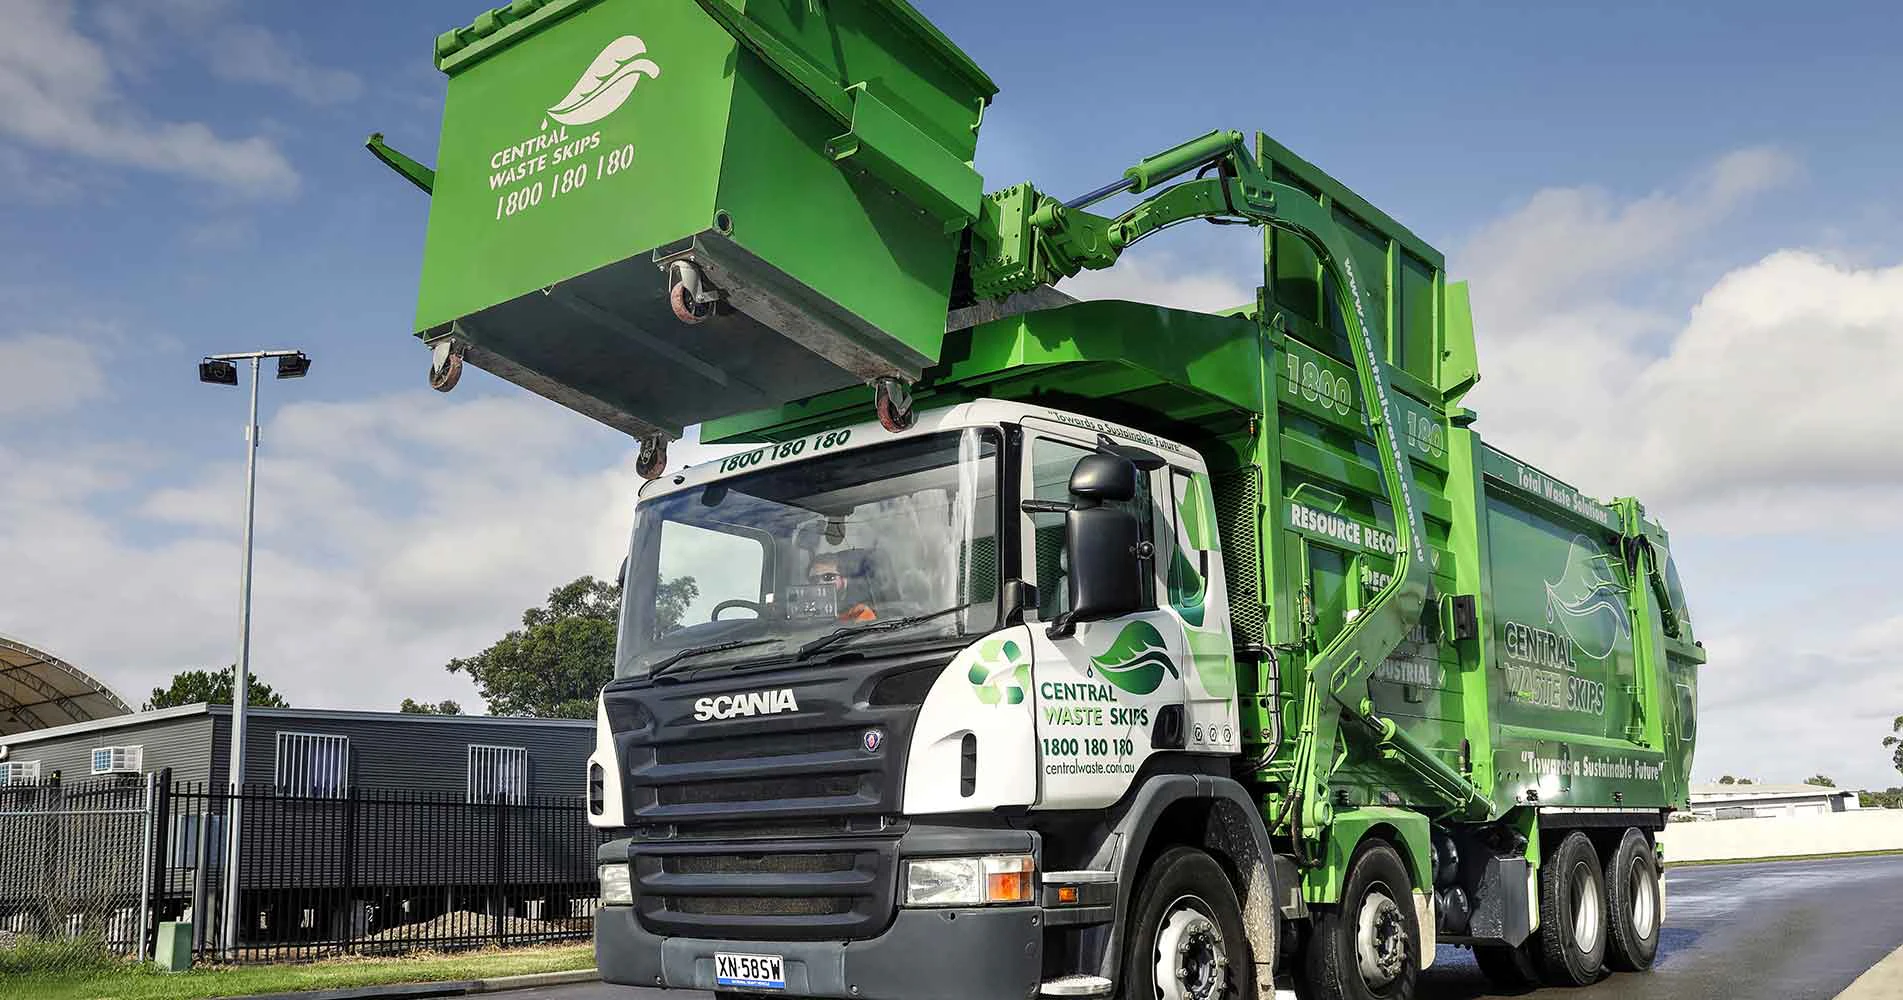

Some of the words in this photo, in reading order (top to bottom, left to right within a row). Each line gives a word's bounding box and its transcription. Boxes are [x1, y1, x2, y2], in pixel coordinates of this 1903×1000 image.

[489, 154, 548, 190] WASTE
[552, 131, 601, 165] SKIPS
[491, 125, 569, 169] CENTRAL
[496, 182, 543, 220] 1800
[551, 164, 588, 198] 180
[597, 143, 635, 180] 180
[1287, 353, 1351, 416] 1800
[1407, 410, 1444, 457] 180
[1344, 256, 1425, 562] www.centralwaste.com.au
[719, 450, 764, 473] 1800
[771, 439, 807, 460] 180
[814, 429, 851, 450] 180
[1106, 423, 1154, 445] Sustainable
[1518, 466, 1541, 494] Total
[1544, 479, 1571, 508] Waste
[1573, 492, 1608, 524] Solutions
[1291, 503, 1360, 545] RESOURCE
[1364, 527, 1395, 554] RECO
[1504, 620, 1576, 672] CENTRAL
[694, 688, 798, 721] SCANIA
[1041, 682, 1117, 702] CENTRAL
[1504, 663, 1562, 708] WASTE
[1568, 676, 1605, 715] SKIPS
[1044, 707, 1103, 726] WASTE
[1110, 707, 1149, 726] SKIPS
[1043, 738, 1079, 756] 1800
[1084, 738, 1108, 756] 180
[1113, 738, 1134, 756] 180
[1045, 758, 1135, 775] centralwaste.com.au
[1573, 762, 1579, 776] a
[1583, 756, 1633, 779] Sustainable
